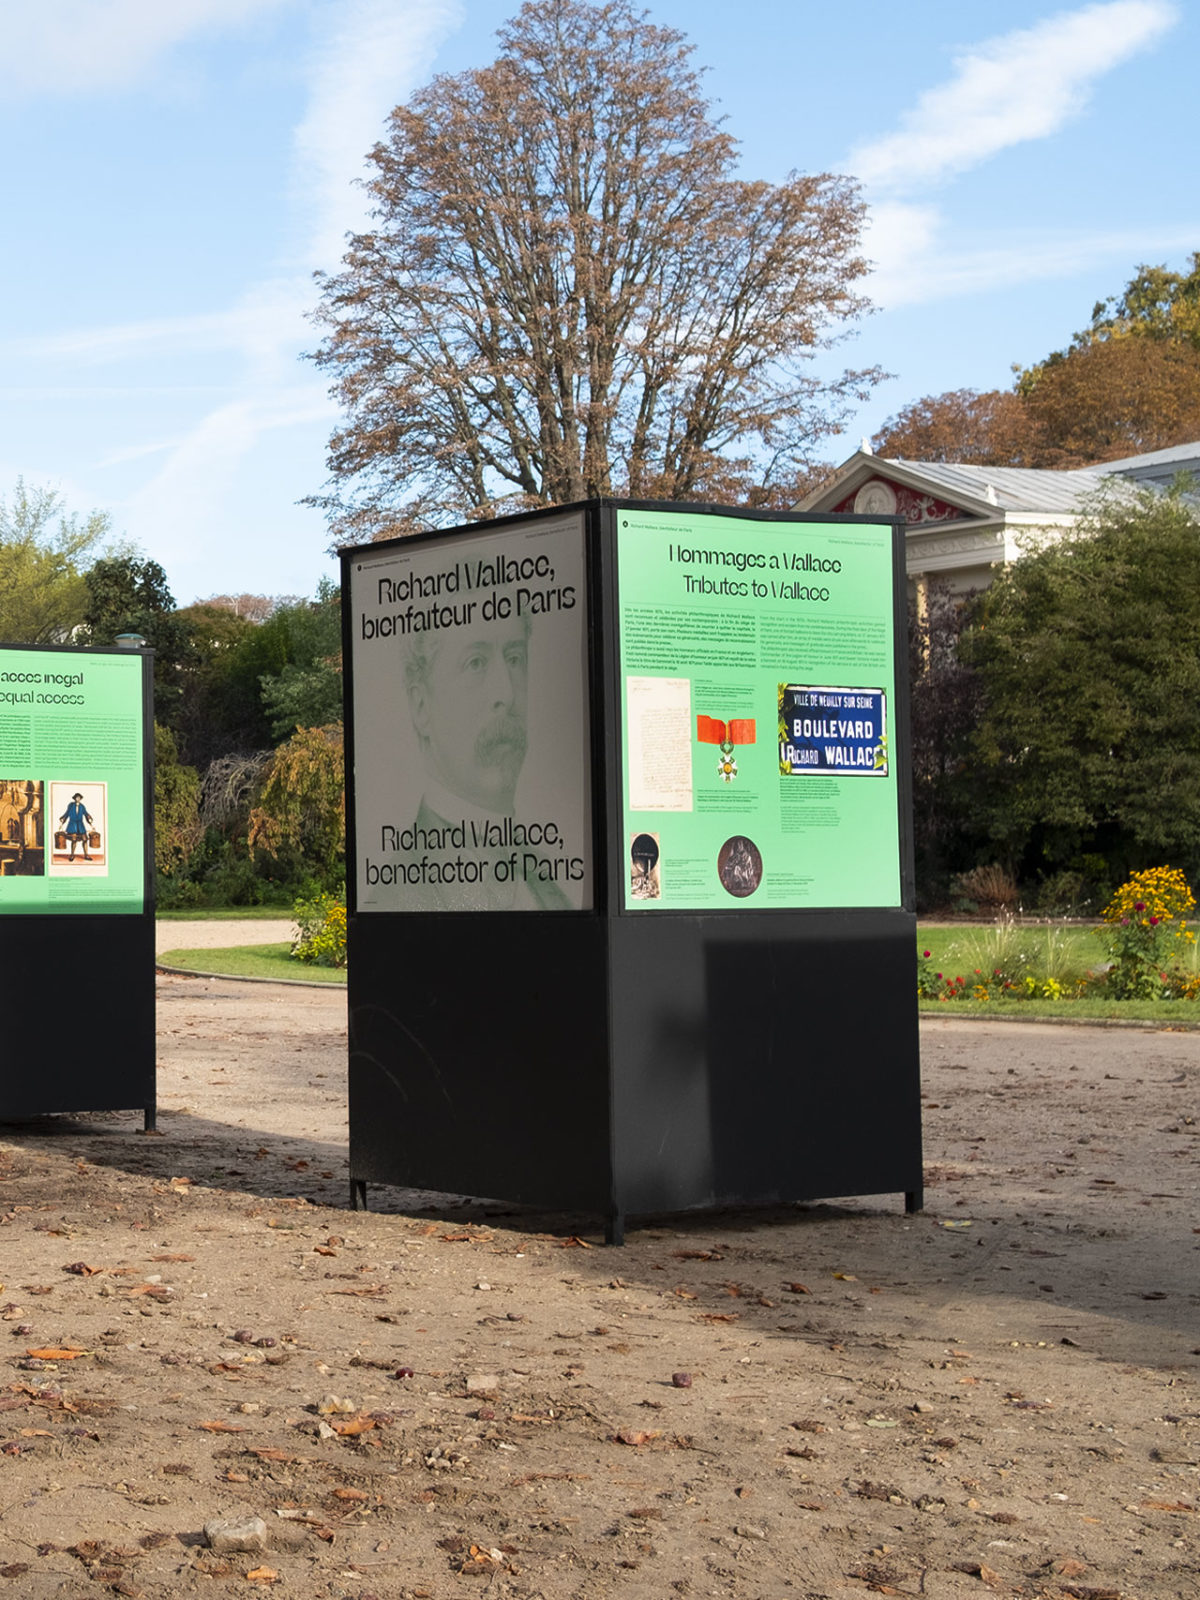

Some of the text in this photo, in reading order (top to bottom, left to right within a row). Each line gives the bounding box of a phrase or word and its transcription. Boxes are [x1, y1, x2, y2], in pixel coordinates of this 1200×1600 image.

[669, 544, 766, 572] Hommages
[783, 552, 842, 574] Wallace
[378, 554, 556, 605] Richard Wallace,
[683, 575, 830, 602] Tributes to Wallace
[361, 586, 577, 641] bienfaiteur de Paris
[37, 692, 85, 706] access
[794, 694, 873, 709] VILLE DE NEUILLY SUR SEINE
[793, 719, 873, 739] BOULEVARD
[786, 745, 819, 765] RICHARD
[381, 817, 564, 852] Richard Wallace,
[366, 852, 584, 886] benefactor of Paris
